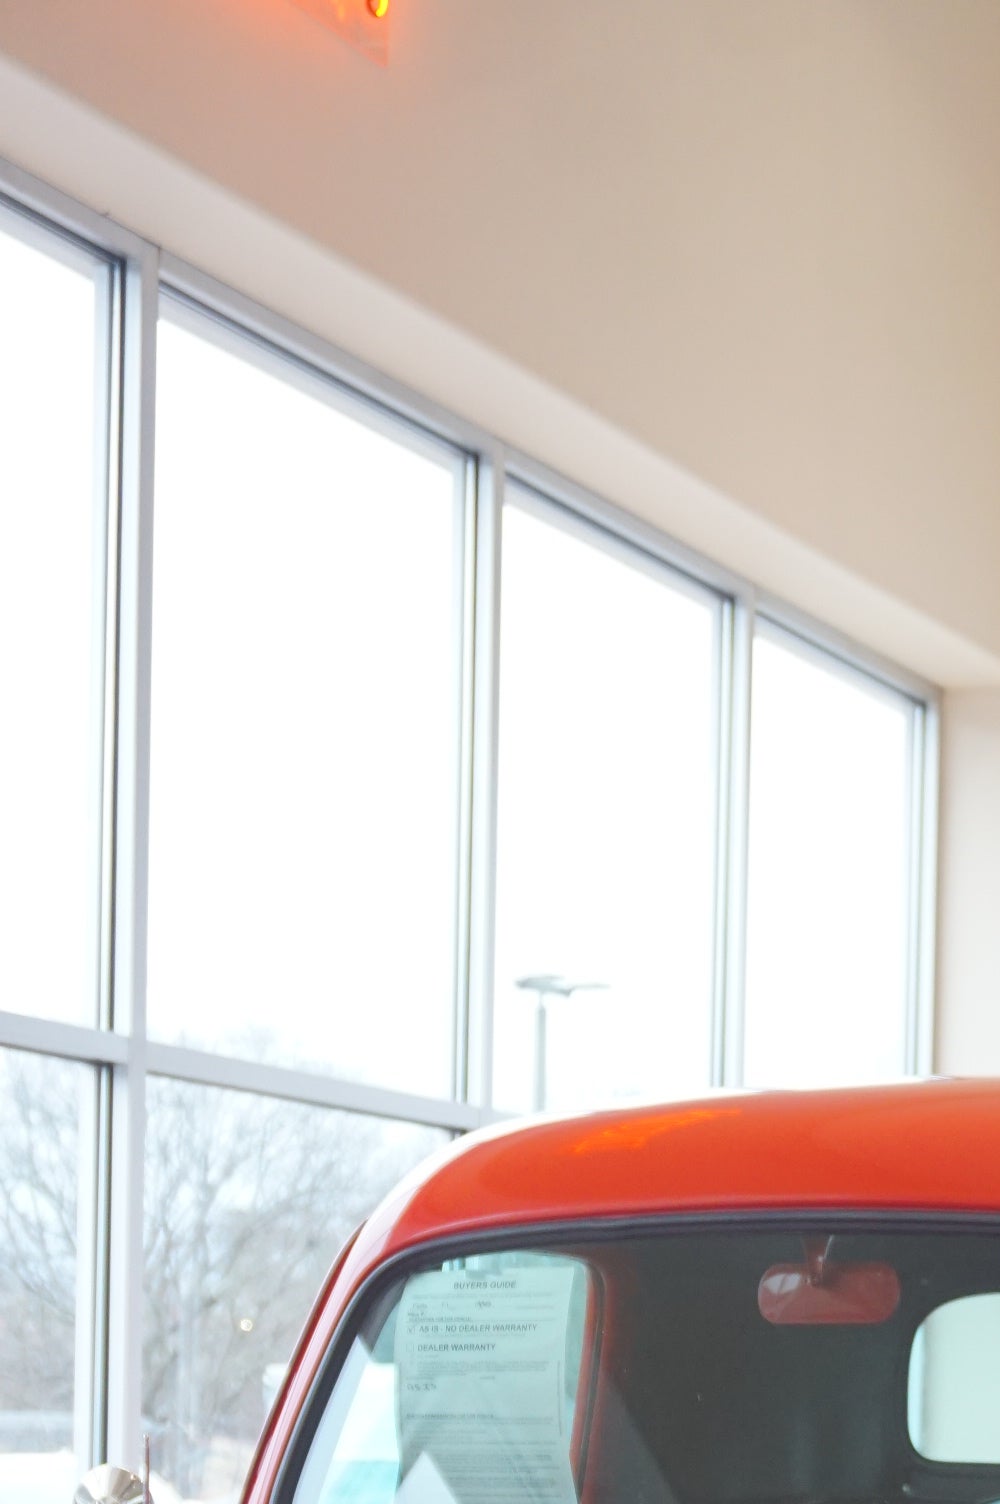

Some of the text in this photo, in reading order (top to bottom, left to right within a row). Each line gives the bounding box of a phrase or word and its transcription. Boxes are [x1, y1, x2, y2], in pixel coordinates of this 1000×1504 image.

[453, 1280, 517, 1290] BUYERS GUIDE
[419, 1325, 430, 1333] AS
[431, 1325, 439, 1333] IS
[458, 1324, 490, 1332] DEALER
[492, 1323, 537, 1332] WARRANTY
[417, 1343, 496, 1352] DEALER WARRANTY
